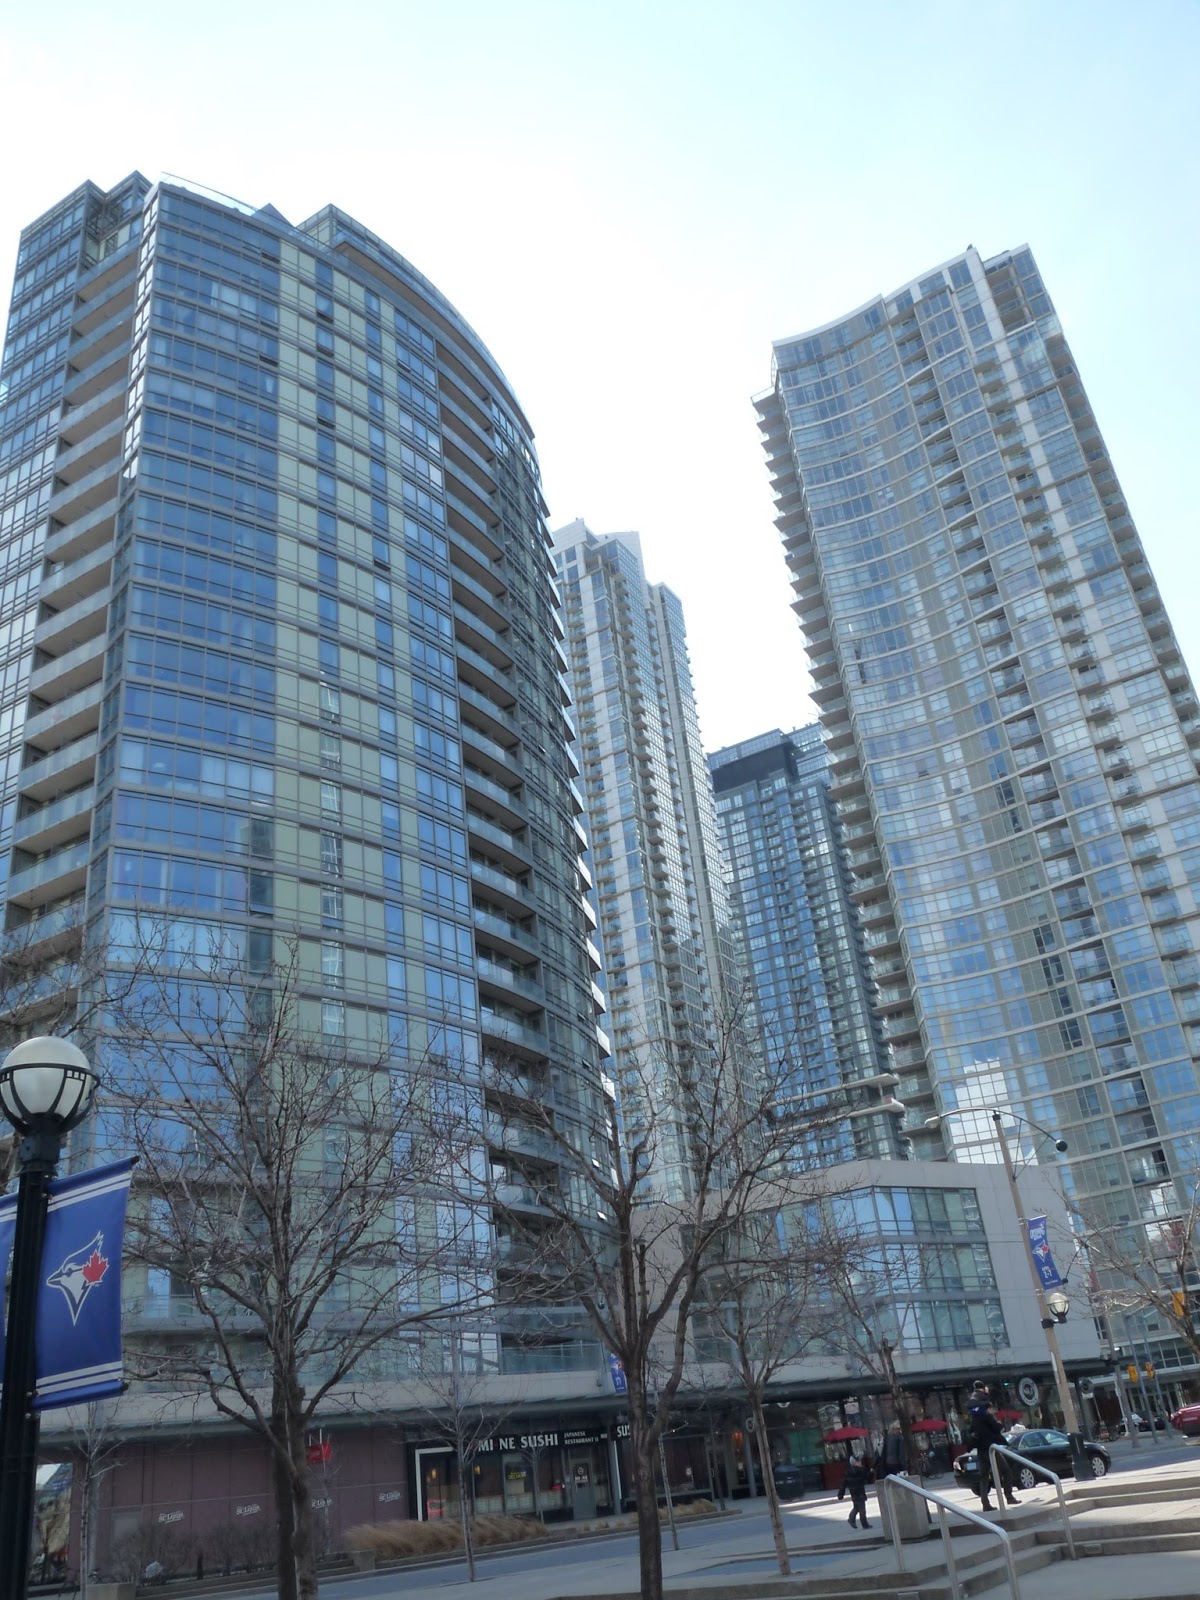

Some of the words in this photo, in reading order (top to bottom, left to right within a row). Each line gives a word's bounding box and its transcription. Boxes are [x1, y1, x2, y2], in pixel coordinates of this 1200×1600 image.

[564, 1430, 586, 1438] JAPANESE
[478, 1438, 494, 1452] MI
[499, 1436, 516, 1451] NE
[520, 1433, 559, 1449] SUSHI
[564, 1436, 594, 1445] RESTAURANT
